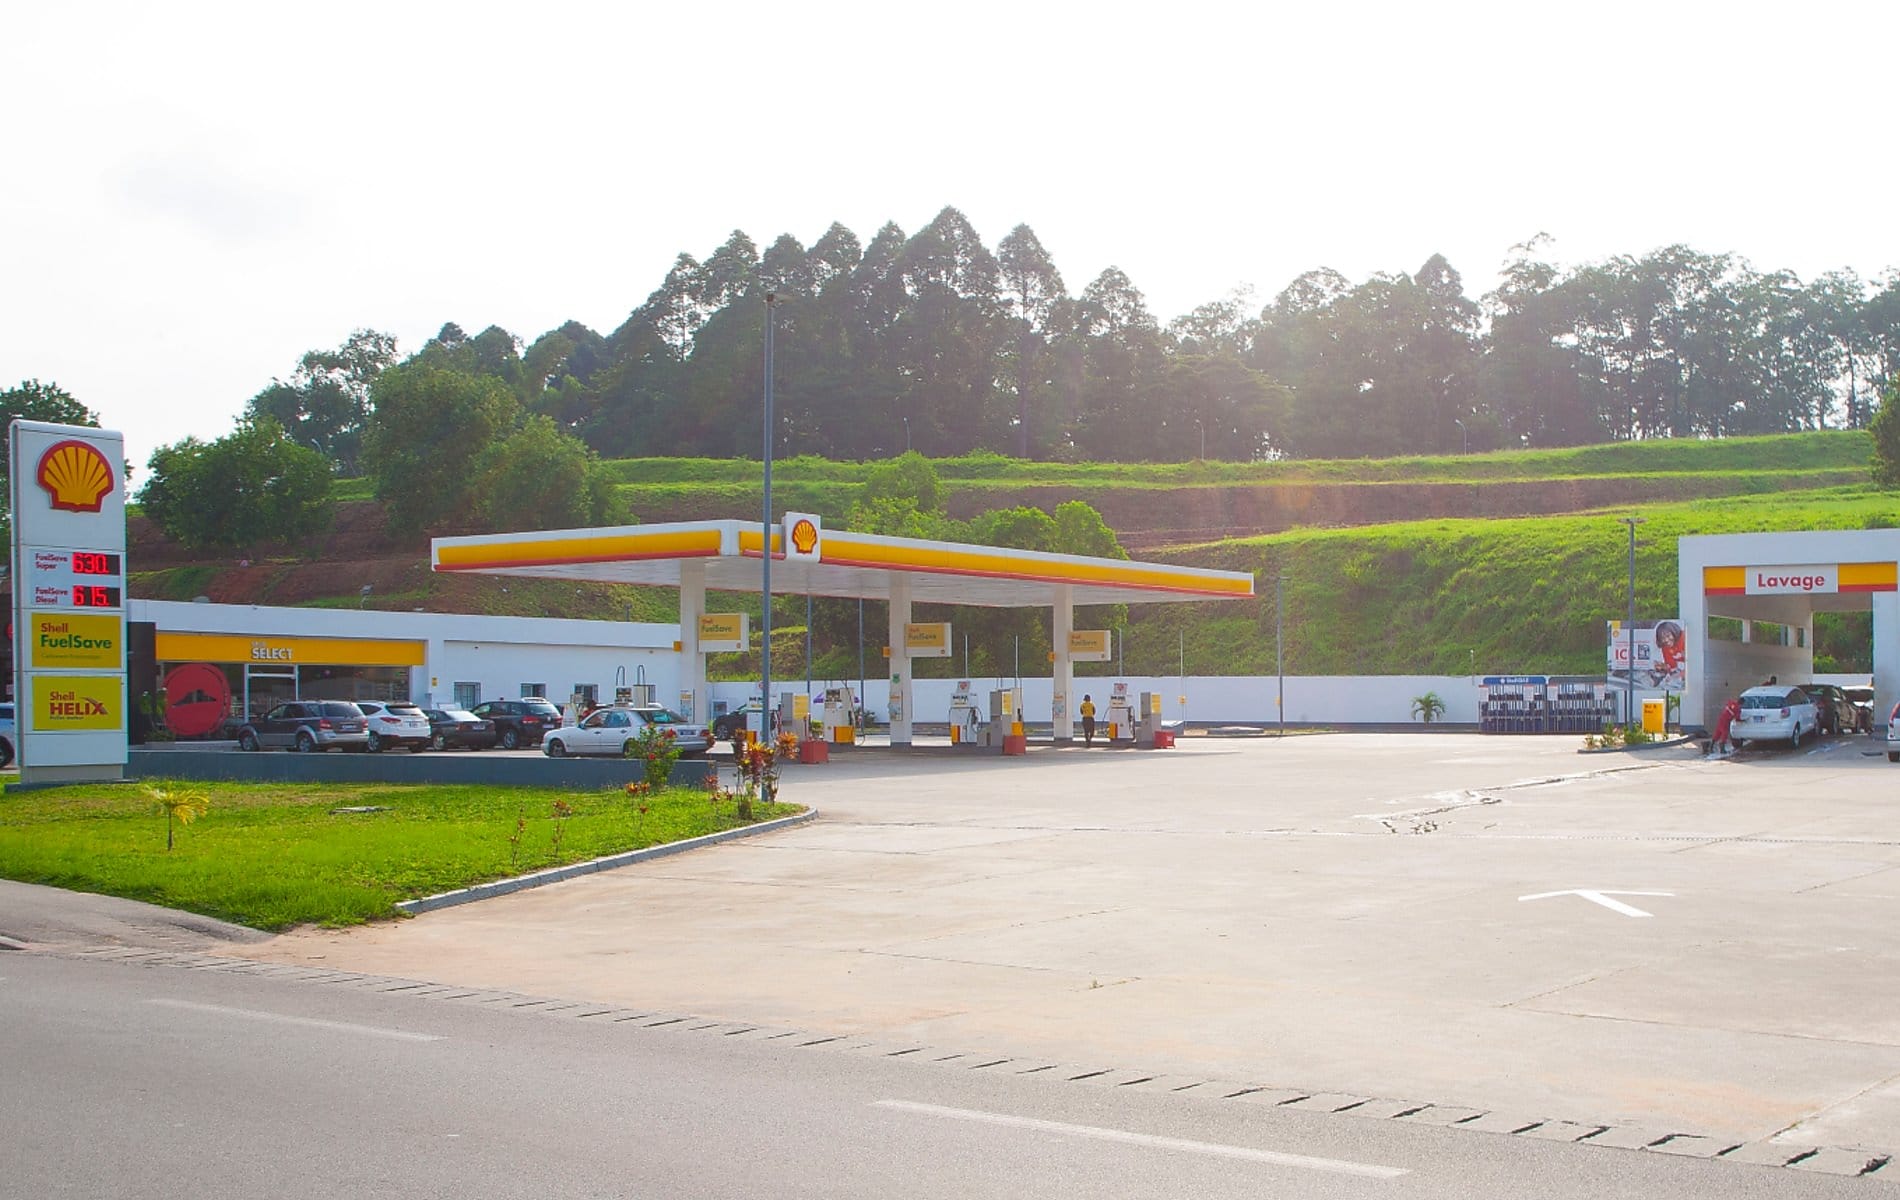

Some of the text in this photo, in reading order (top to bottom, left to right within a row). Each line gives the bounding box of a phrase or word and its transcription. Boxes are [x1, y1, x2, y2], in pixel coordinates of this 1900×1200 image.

[35, 553, 68, 562] FuelSave
[35, 561, 57, 570] Super
[1757, 573, 1825, 591] Lavage
[35, 587, 68, 596] FuelSave
[35, 596, 58, 604] Diesel
[41, 623, 68, 633] Shell
[40, 634, 112, 649] FuelSave
[252, 648, 293, 660] SELECT
[50, 691, 75, 700] Shell
[50, 700, 108, 716] HELIX
